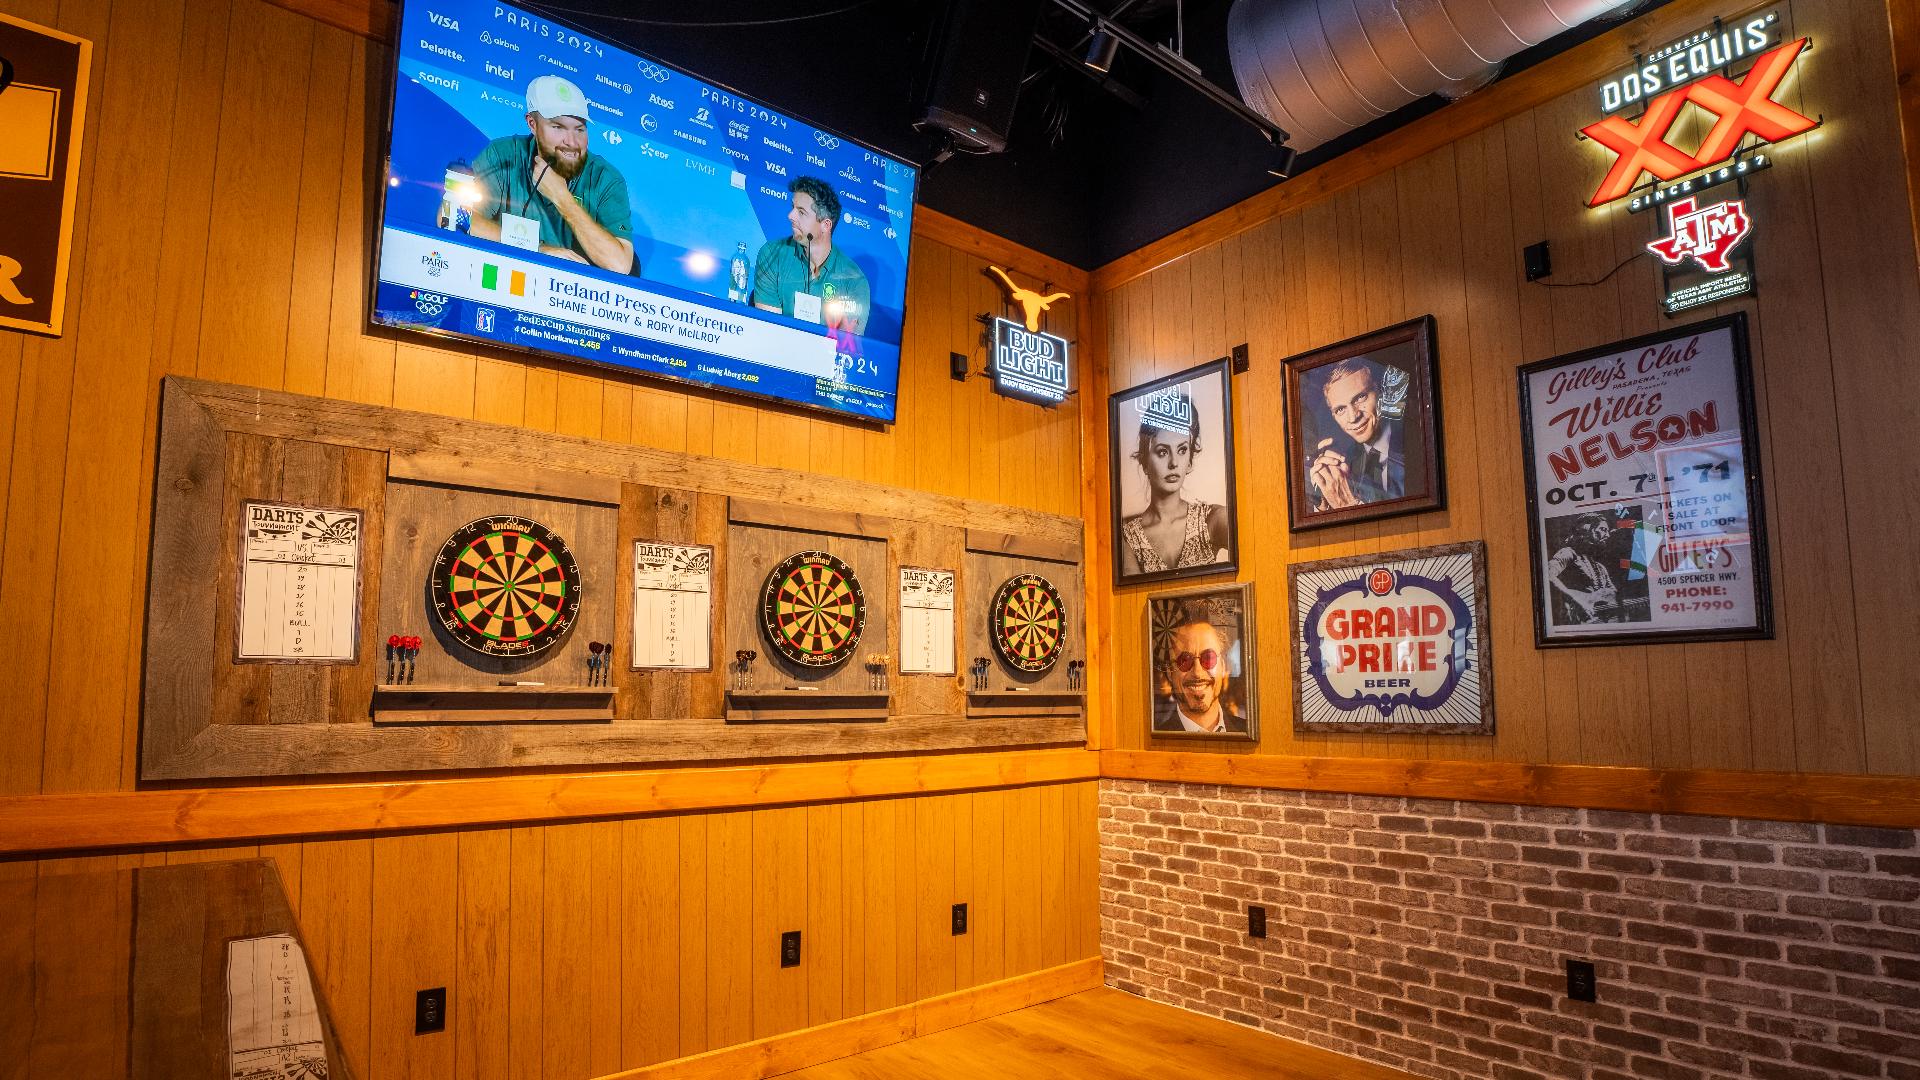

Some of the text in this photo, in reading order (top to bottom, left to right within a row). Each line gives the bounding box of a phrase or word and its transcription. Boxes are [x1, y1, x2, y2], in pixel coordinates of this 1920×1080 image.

[428, 11, 459, 32] VISA
[494, 7, 603, 57] PARIS 2024
[493, 37, 520, 52] airbnb
[1649, 30, 1711, 63] CERVEZA
[485, 60, 514, 81] intel
[548, 57, 578, 73] Alibaba
[1602, 18, 1767, 112] DOS EQUIS
[418, 71, 460, 91] sanofi
[595, 73, 621, 90] Allianz
[491, 95, 523, 111] ACCOR
[586, 97, 624, 117] Panasonic
[649, 93, 674, 110] Atos
[701, 86, 787, 130] PARIS 2024
[1579, 37, 1821, 208] XX
[673, 129, 707, 147] SAMSUNG
[721, 146, 750, 162] TOYOTA
[806, 152, 826, 169] intel
[685, 158, 716, 176] LVMH
[764, 160, 787, 177] VISA
[864, 152, 899, 174] PARIS
[1632, 155, 1765, 208] SINCE 1897
[421, 255, 449, 270] PARIS
[1672, 285, 1699, 296] OFFICIAL
[1700, 279, 1723, 289] IMPORT
[1677, 291, 1697, 300] TEXAS
[1714, 277, 1747, 290] ATHLETICS
[424, 293, 449, 305] GOLF
[549, 277, 744, 336] Ireland Press Conference
[517, 313, 611, 341] FedExCup Standings
[549, 297, 721, 344] SHANE LOWRY & RORY McILROY
[521, 327, 542, 340] Collin
[543, 332, 579, 346] Morikawa
[580, 339, 600, 350] 2,456
[1009, 328, 1054, 359] BUD
[618, 347, 651, 361] Wyndham
[652, 354, 669, 364] Clark
[1001, 345, 1063, 383] LIGHT
[702, 366, 723, 376] Ludwig
[723, 368, 741, 380] Åberg
[742, 373, 759, 383] 2,092
[1545, 336, 1703, 404] Gilley's Club
[1663, 366, 1691, 377] TEXAS
[1001, 378, 1018, 388] ENJOY
[1547, 400, 1720, 484] NELSON
[1546, 480, 1618, 505] OCT.
[1682, 461, 1731, 483] '71
[1657, 493, 1731, 510] TICKETS ON
[252, 508, 304, 524] DARTS
[1668, 506, 1720, 520] SALE AT
[252, 521, 300, 531] Tournament
[491, 523, 531, 533] WINMAU
[1656, 517, 1736, 533] FRONT DOOR
[291, 553, 316, 562] Cricket
[639, 546, 674, 558] DARTS
[803, 557, 830, 565] WINMAU
[904, 572, 928, 582] DARTS
[1658, 577, 1676, 586] 4500
[1680, 574, 1715, 584] SPENCER
[1666, 586, 1727, 598] PHONE:
[1661, 600, 1734, 613] 941-7990
[1325, 605, 1447, 640] GRAND
[1364, 678, 1411, 688] BEER
